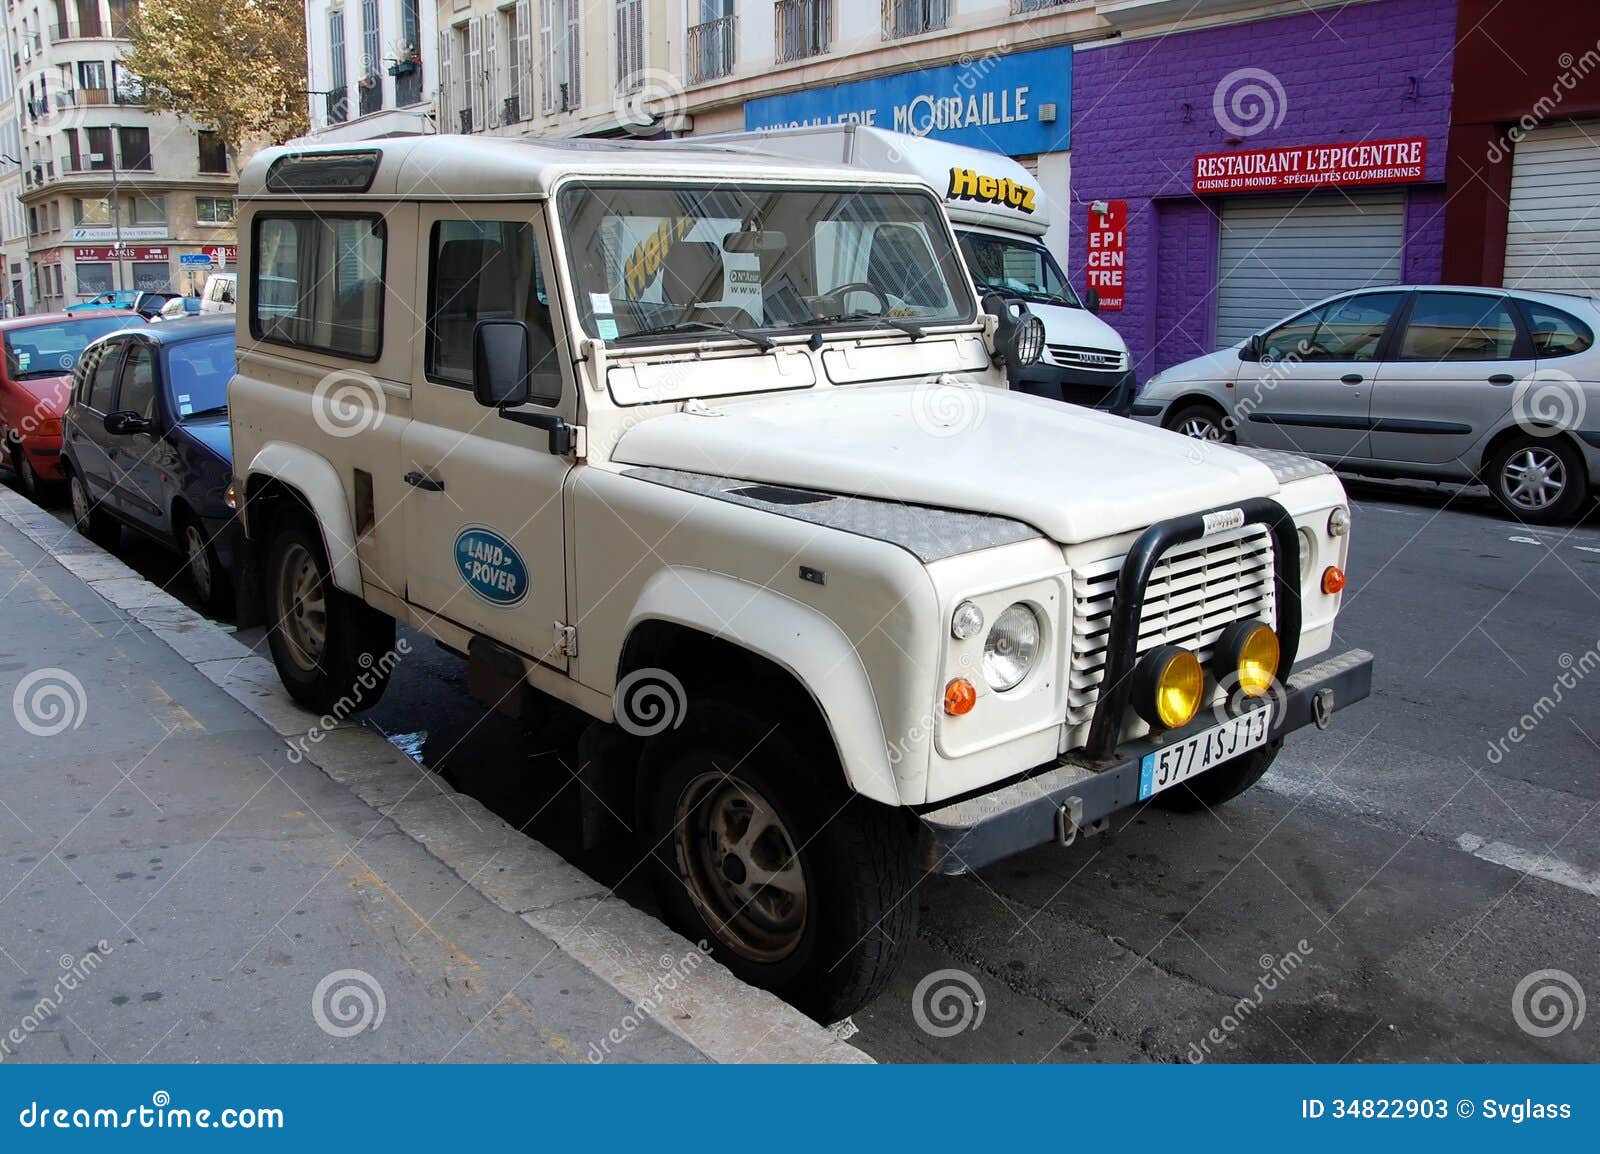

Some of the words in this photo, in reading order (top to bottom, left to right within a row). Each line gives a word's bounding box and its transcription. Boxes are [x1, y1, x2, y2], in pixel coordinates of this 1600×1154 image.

[893, 86, 1029, 137] MOURAILLE
[1197, 151, 1302, 178] RESTAURANT
[1306, 141, 1422, 170] L'EPICENTRE
[1197, 179, 1229, 189] CUISINE
[1231, 178, 1243, 188] DU
[1245, 176, 1277, 187] MONDE
[1283, 169, 1341, 185] SPÉCIALITÉS
[1342, 166, 1421, 181] COLOMBIENNES
[949, 167, 1036, 213] Hertz
[1099, 212, 1114, 229] L'
[1090, 231, 1123, 248] EPI
[1088, 251, 1124, 267] CEN
[1088, 270, 1122, 286] TRE
[730, 286, 760, 295] www.
[1099, 298, 1122, 306] AURANT
[467, 537, 503, 566] LAND
[472, 560, 516, 594] ROVER
[1159, 740, 1198, 786] 577
[1202, 721, 1239, 767] ASJ
[1244, 710, 1266, 747] 13
[1142, 784, 1149, 796] F
